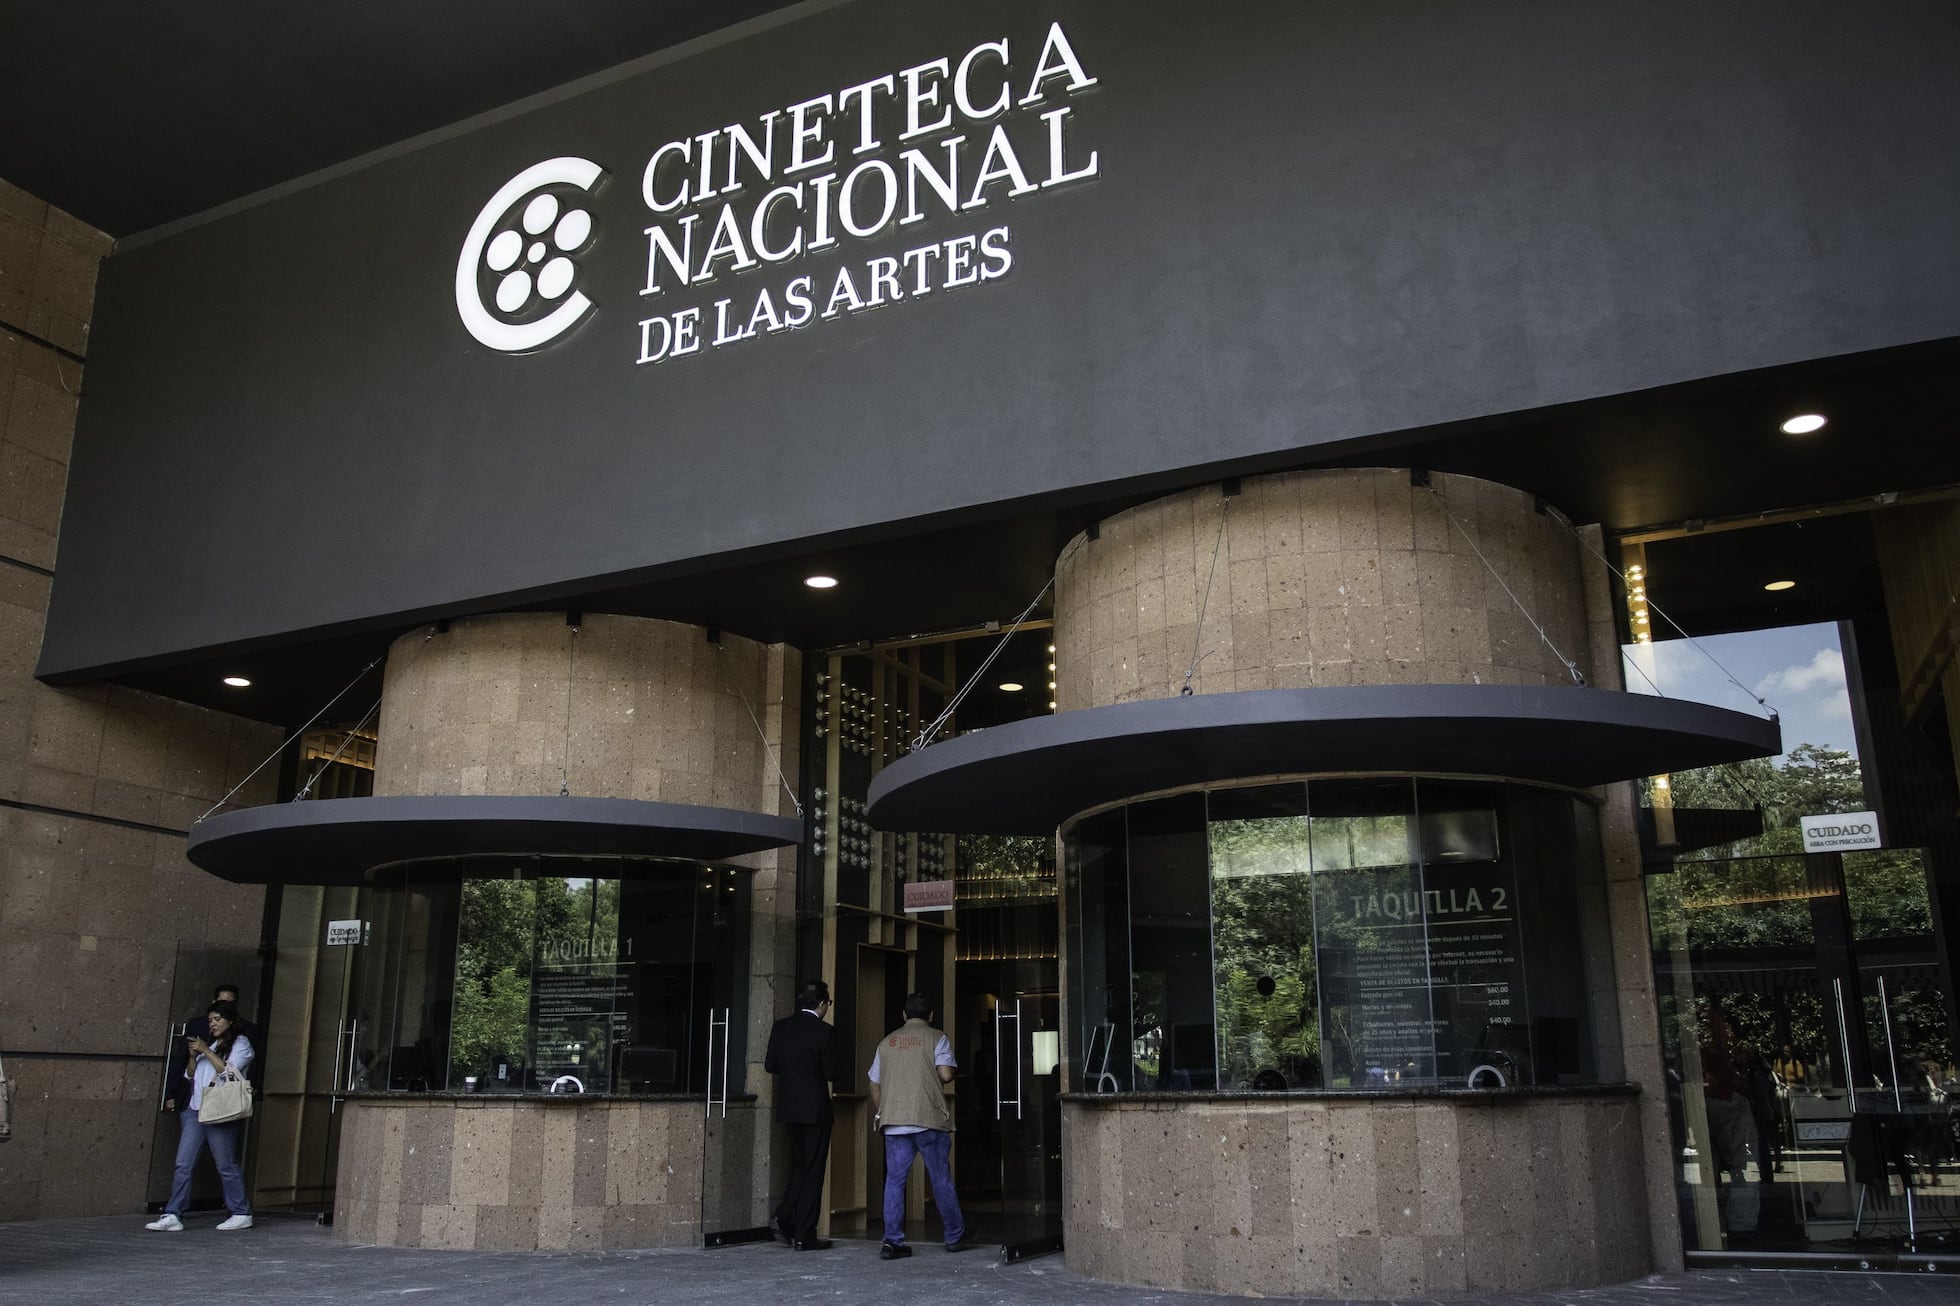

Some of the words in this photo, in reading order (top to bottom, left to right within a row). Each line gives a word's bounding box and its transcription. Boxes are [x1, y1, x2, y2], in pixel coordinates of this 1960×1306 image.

[642, 22, 1098, 213] CINETECA
[639, 106, 1099, 297] NACIONAL
[636, 308, 700, 365] DE
[712, 276, 814, 346] LAS
[821, 227, 1015, 320] ARTES
[1807, 824, 1872, 838] CUIDADO
[908, 892, 949, 901] CUIDADO
[1350, 887, 1484, 920] TAQUILLA
[1491, 887, 1508, 911] 2
[541, 937, 620, 961] TAQUILLA
[626, 937, 633, 956] 1
